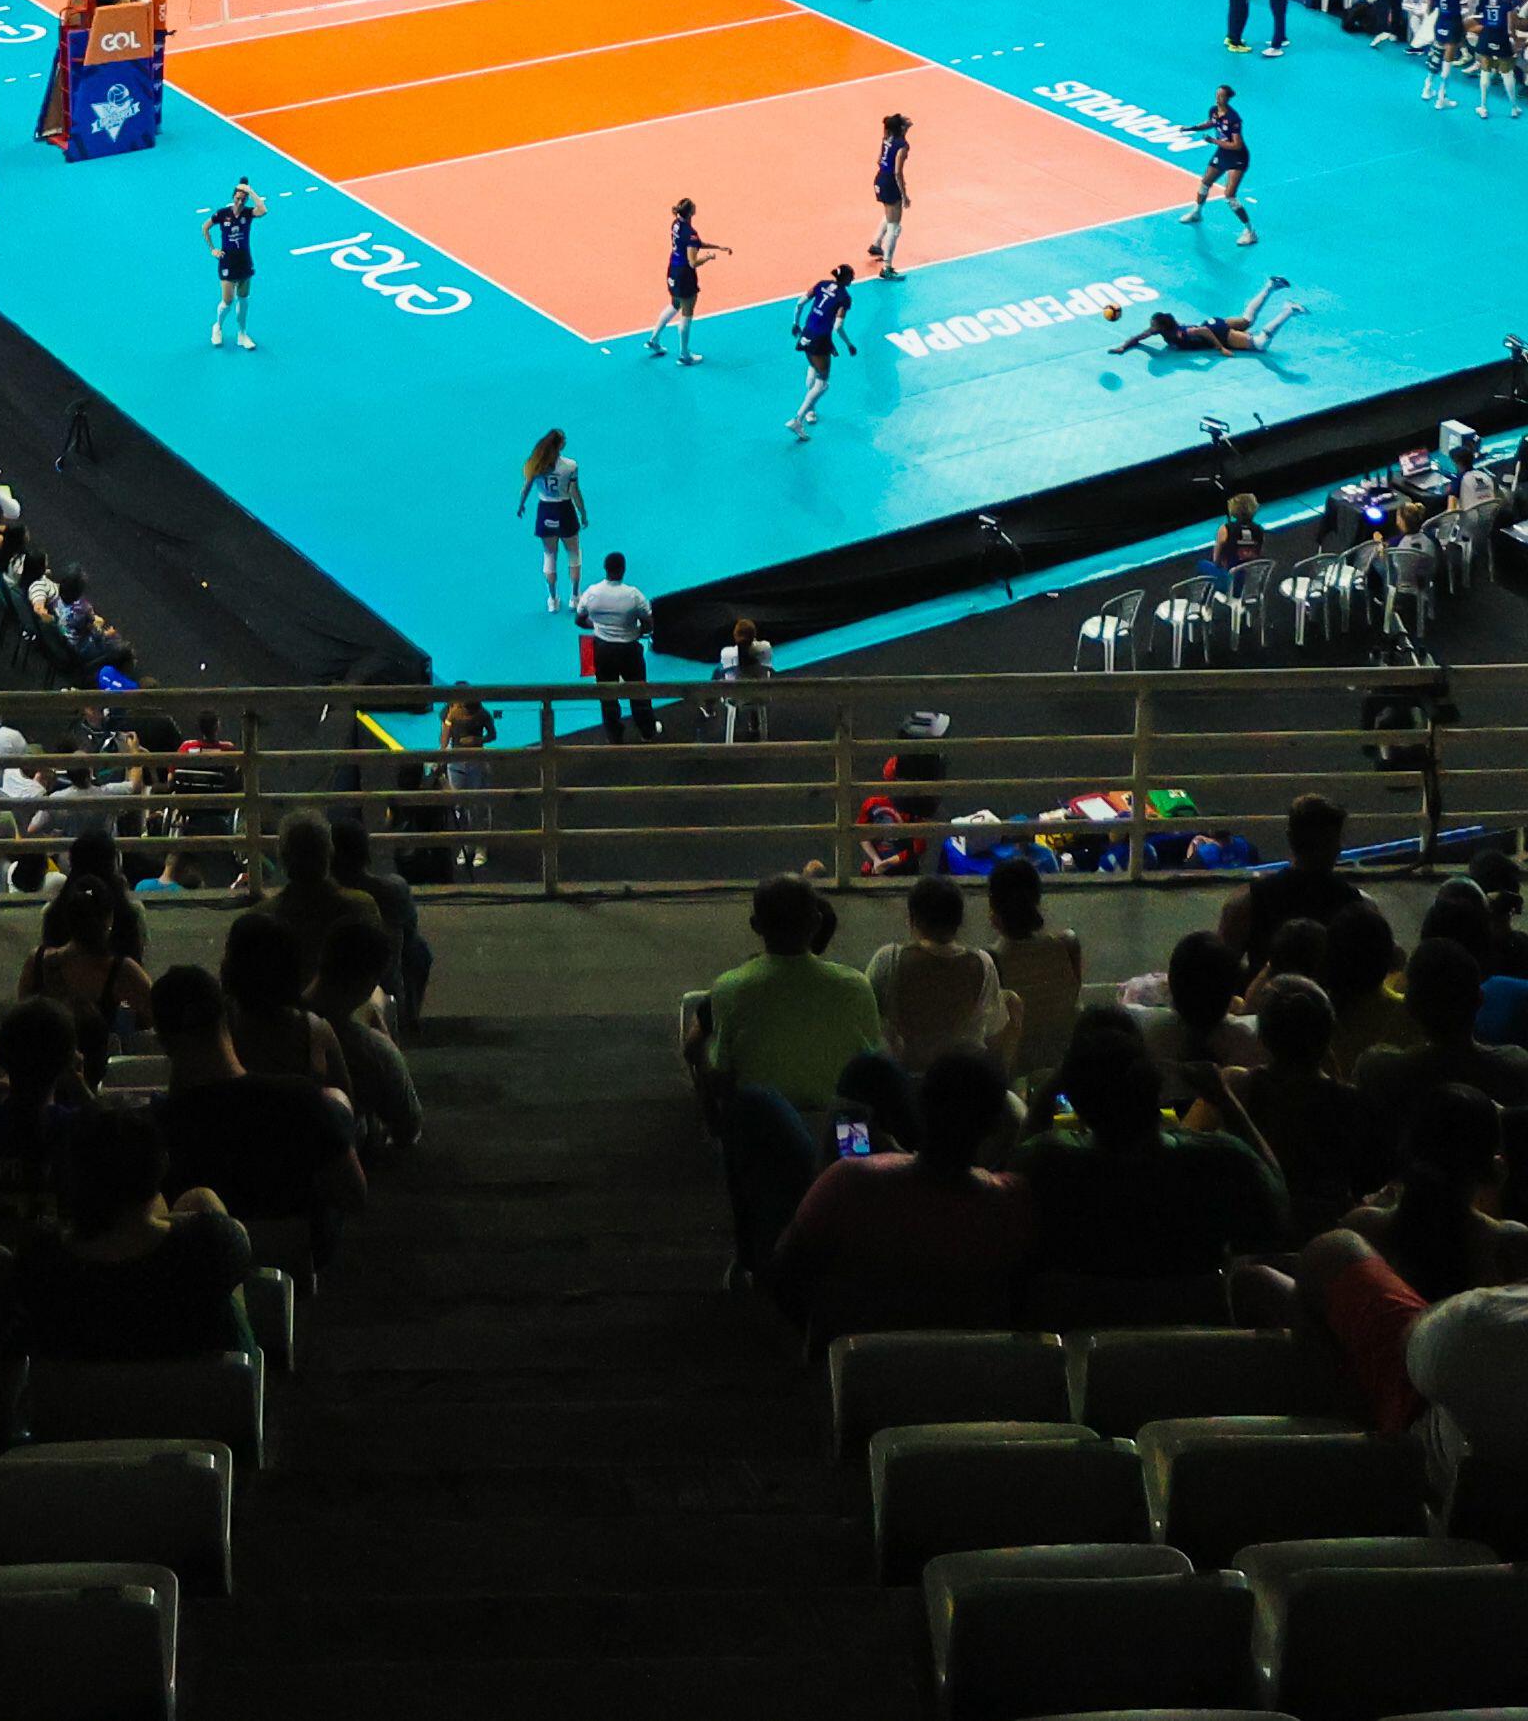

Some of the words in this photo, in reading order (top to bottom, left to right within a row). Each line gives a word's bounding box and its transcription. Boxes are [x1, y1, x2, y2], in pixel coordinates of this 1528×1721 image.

[100, 31, 141, 53] GOL
[1486, 9, 1499, 21] 13
[1032, 80, 1210, 153] MANAUS
[290, 232, 472, 315] enel
[884, 276, 1160, 358] SUPERCOPA
